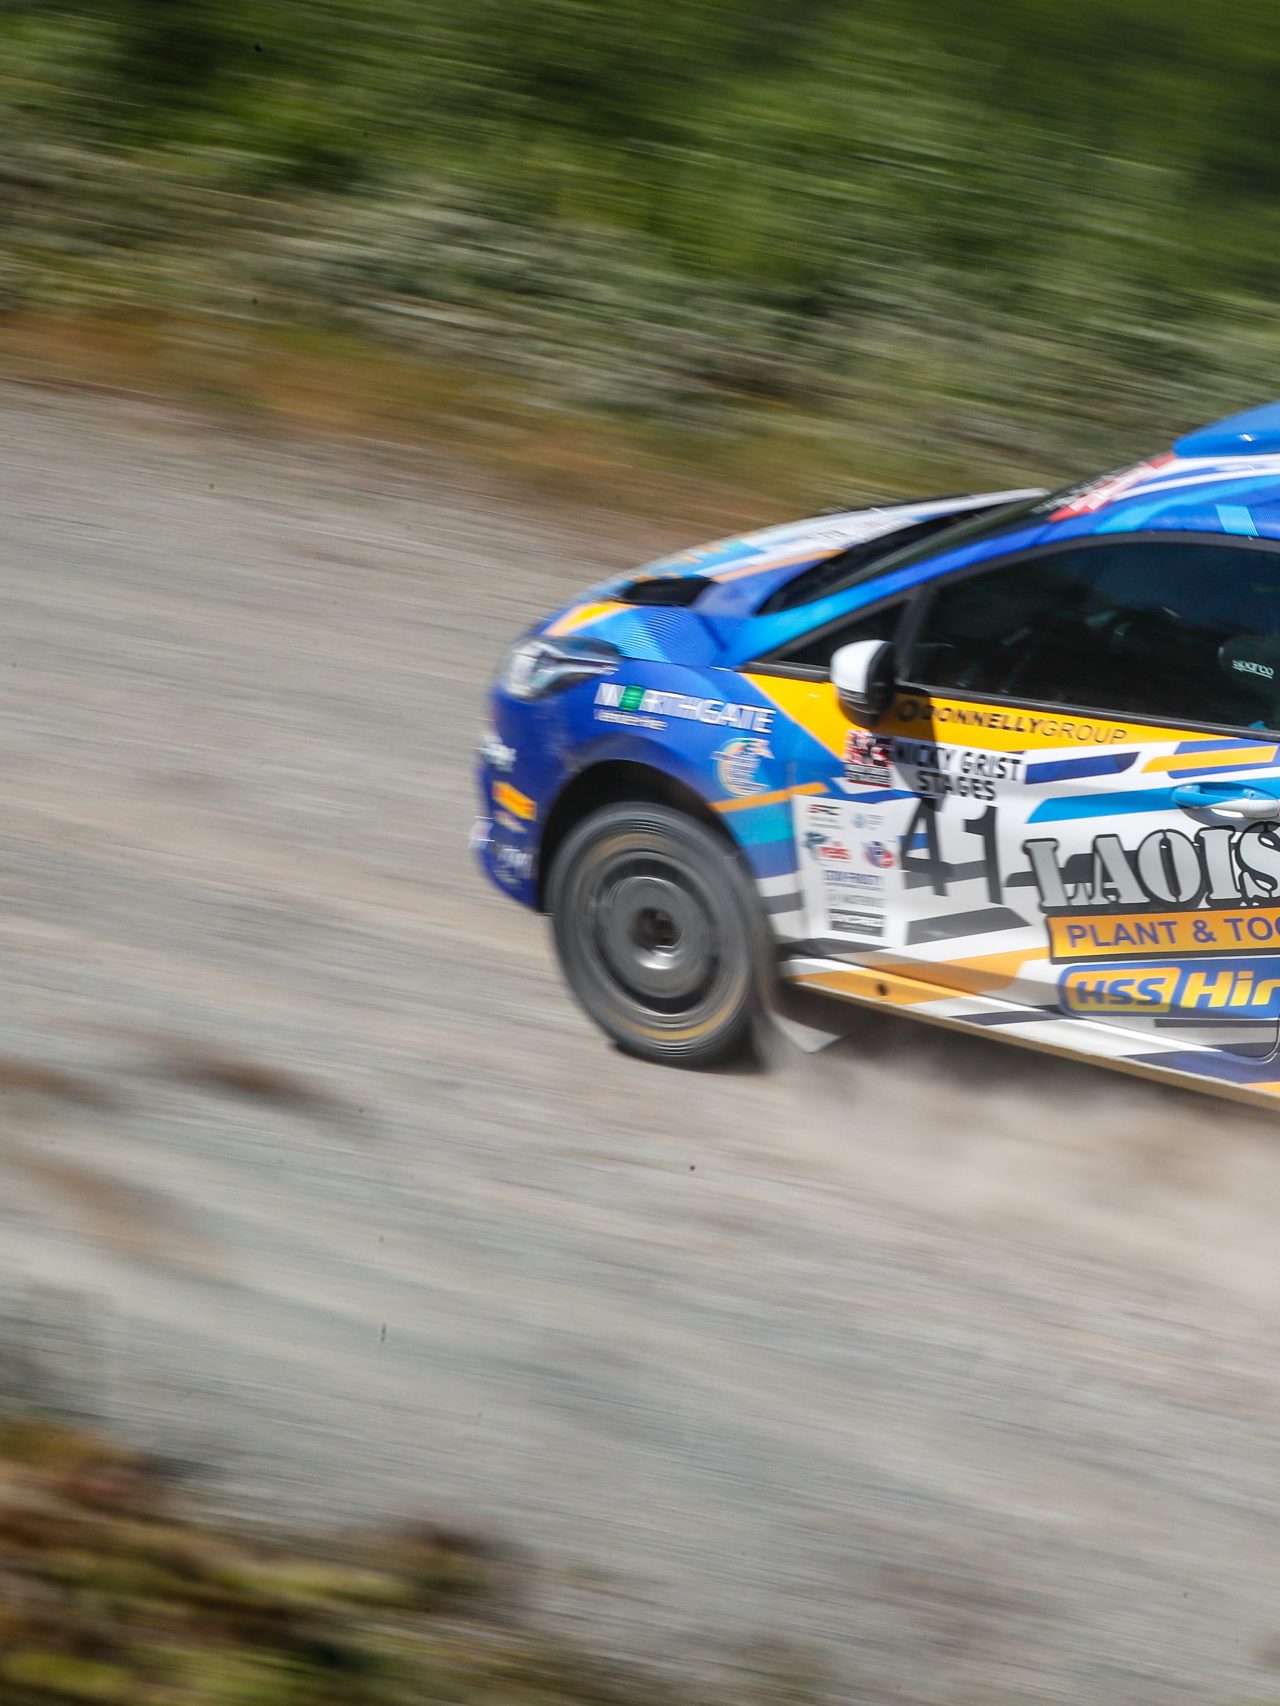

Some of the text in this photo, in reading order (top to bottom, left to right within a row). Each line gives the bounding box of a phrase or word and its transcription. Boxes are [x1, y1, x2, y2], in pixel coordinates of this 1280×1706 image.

[962, 751, 1021, 781] GRIST
[918, 770, 995, 801] STAGES
[1068, 917, 1178, 949] PLANT
[1192, 917, 1217, 943] &
[1077, 974, 1169, 1006] HSS
